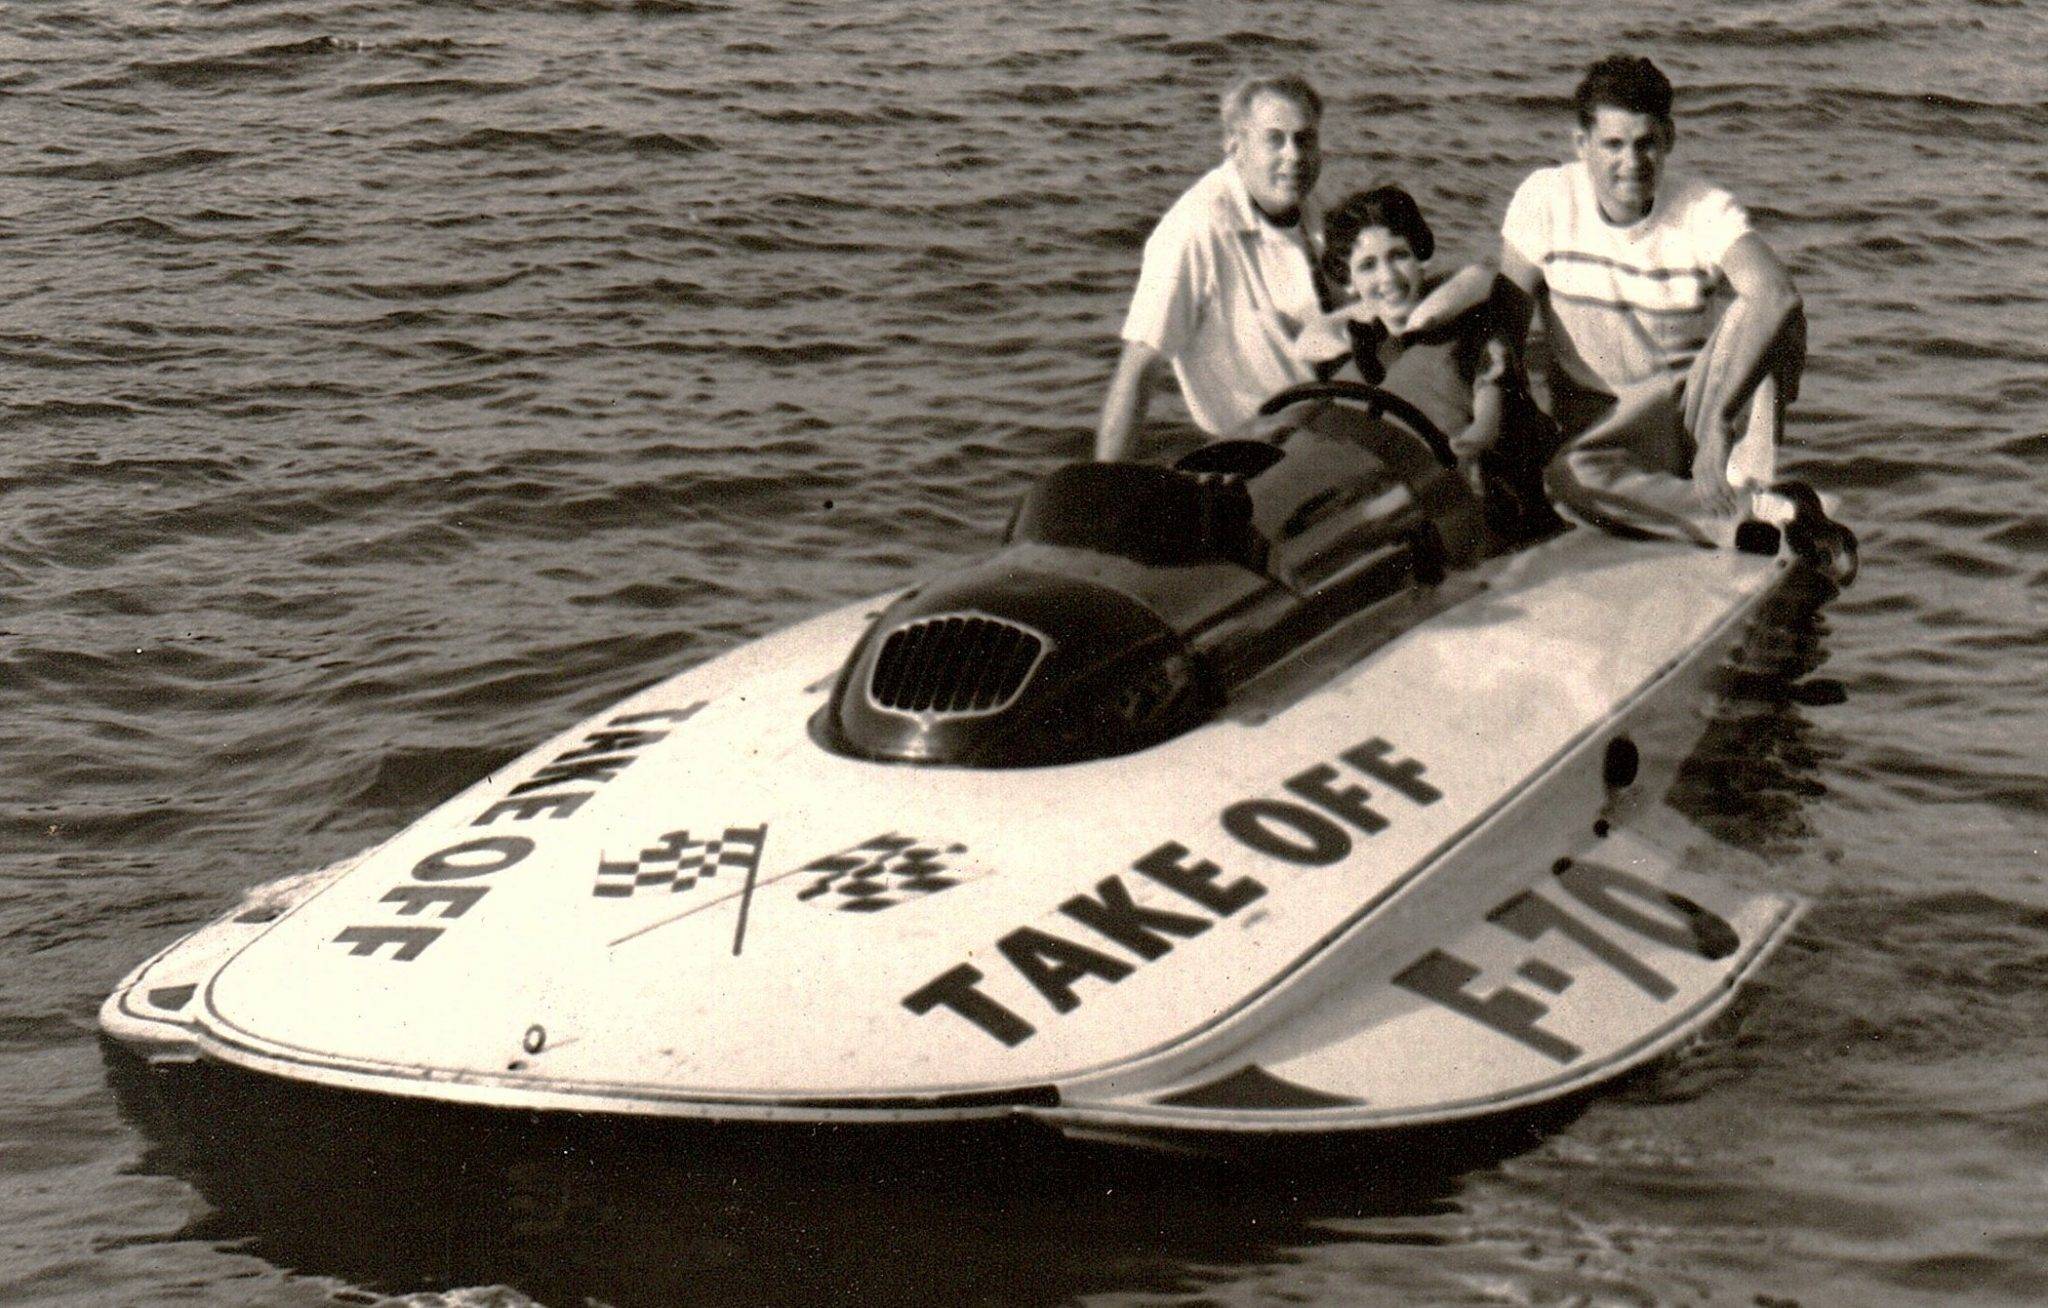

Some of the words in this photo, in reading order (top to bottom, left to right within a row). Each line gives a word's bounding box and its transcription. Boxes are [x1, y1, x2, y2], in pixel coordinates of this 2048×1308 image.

[469, 700, 709, 827] TAKE
[332, 835, 536, 962] OFF
[901, 840, 1268, 1047] TAKE
[1219, 736, 1443, 867] OFF
[1391, 858, 1740, 1065] F-70
